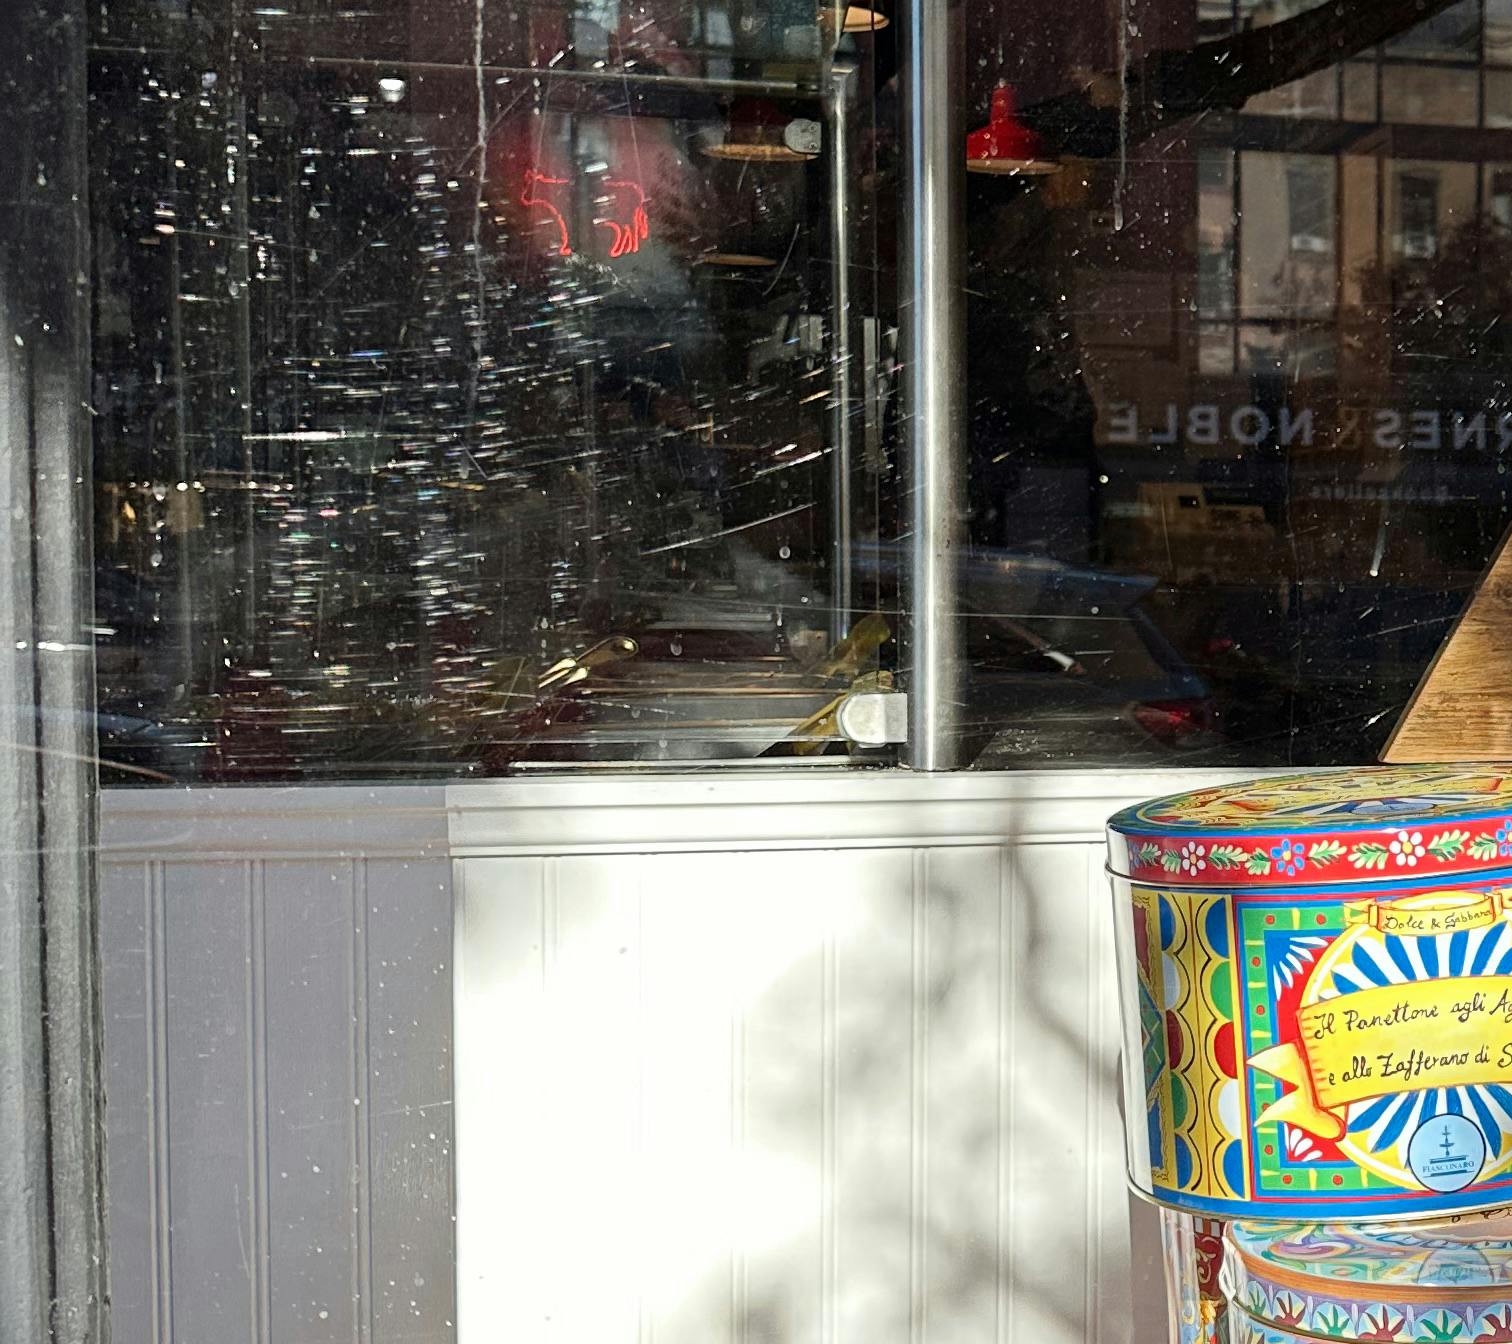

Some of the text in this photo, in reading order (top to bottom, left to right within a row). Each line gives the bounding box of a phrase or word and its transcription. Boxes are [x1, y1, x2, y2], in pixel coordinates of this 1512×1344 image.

[1383, 908, 1494, 933] Dolce & Gabbana
[1345, 1004, 1438, 1034] Panettone
[1450, 994, 1485, 1026] agli
[1328, 1071, 1337, 1086] e
[1378, 1045, 1469, 1082] Zafferano
[1475, 1042, 1491, 1067] di
[1421, 1160, 1476, 1175] FIASCONARO
